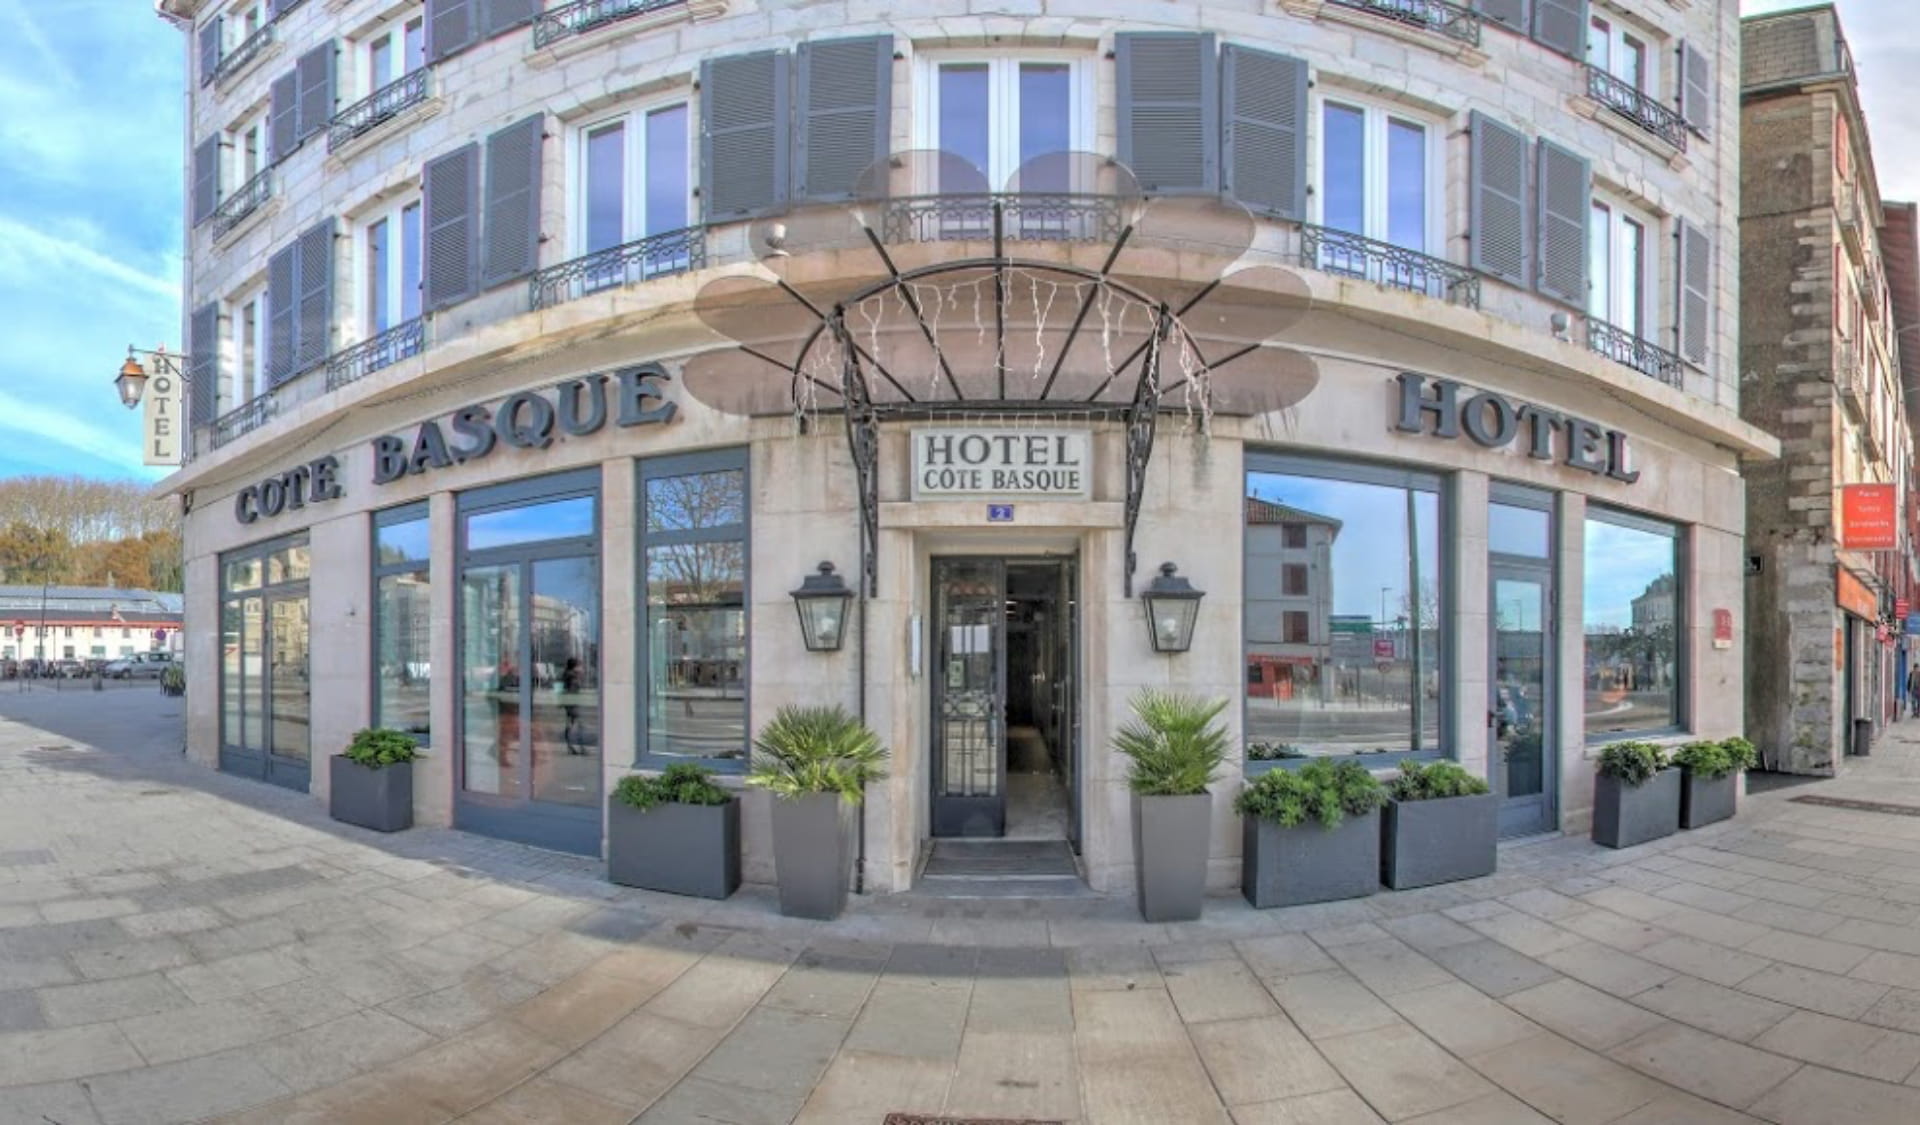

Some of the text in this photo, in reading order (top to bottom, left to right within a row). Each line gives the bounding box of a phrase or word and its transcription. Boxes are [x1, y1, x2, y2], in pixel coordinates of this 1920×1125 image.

[152, 354, 171, 457] HOTEL
[235, 361, 678, 524] COTE BASQUE
[924, 434, 1080, 466] HOTEL
[1396, 372, 1640, 484] HOTEL
[991, 469, 1080, 491] BASQUE
